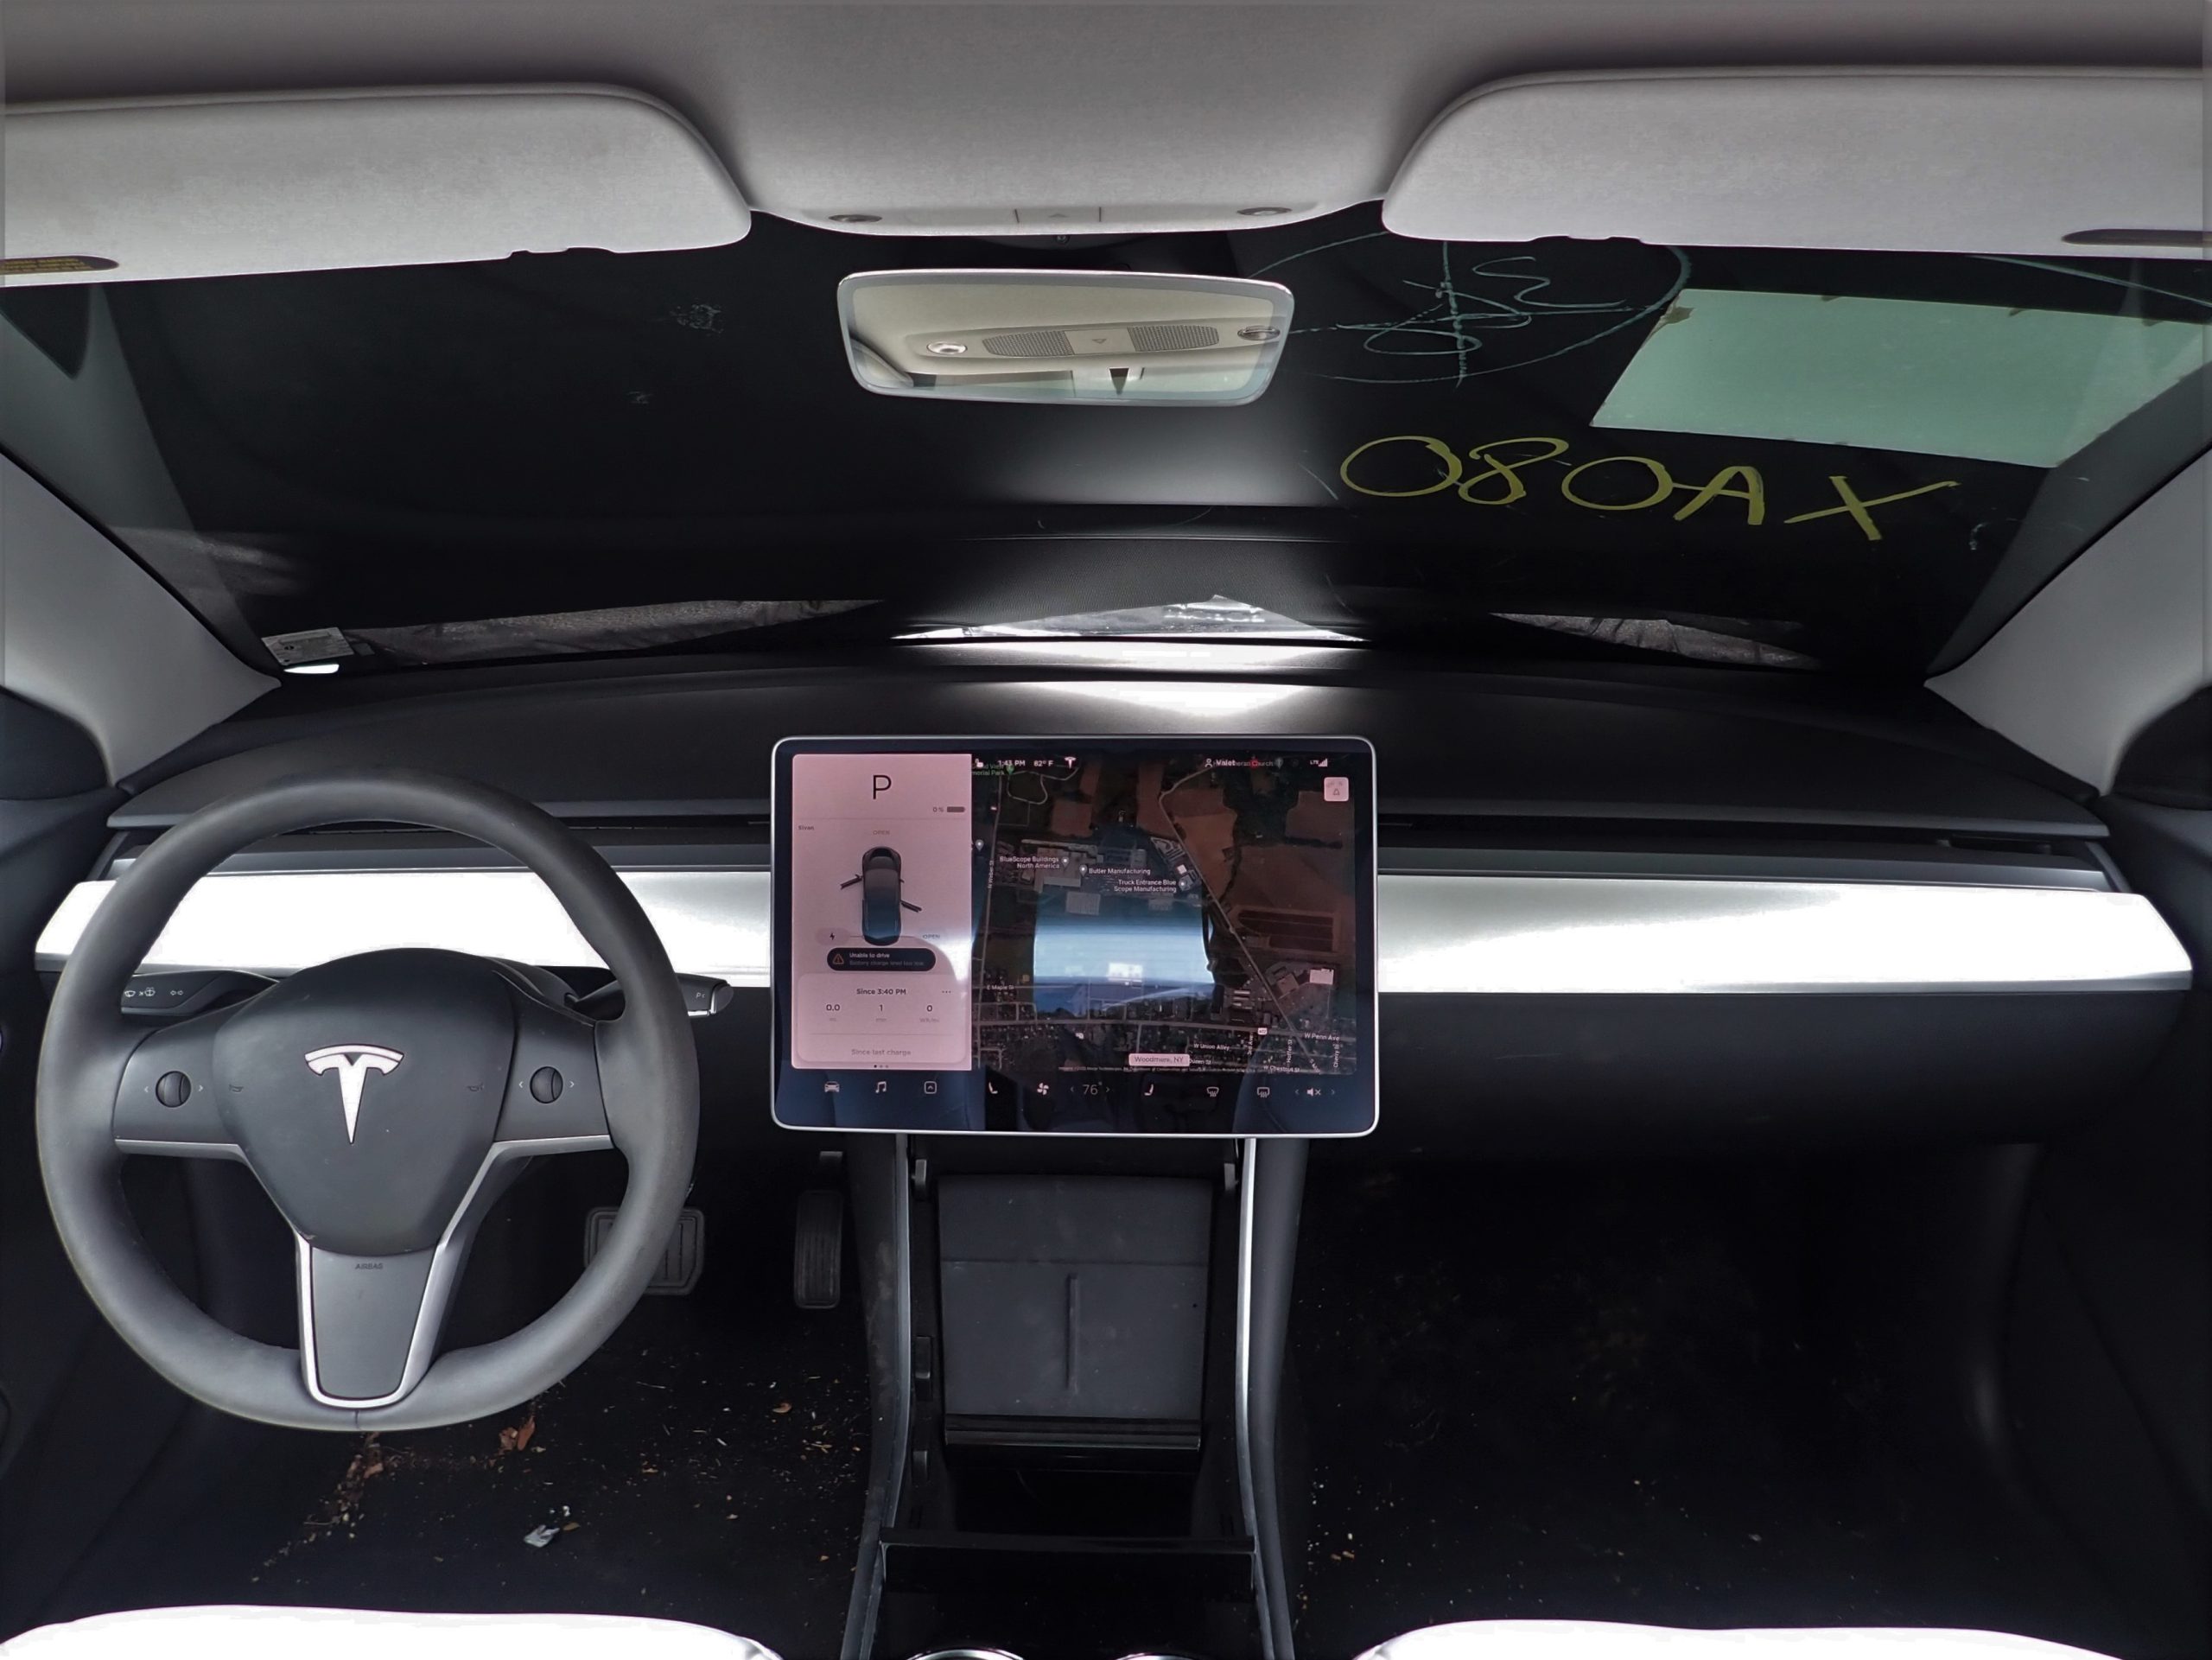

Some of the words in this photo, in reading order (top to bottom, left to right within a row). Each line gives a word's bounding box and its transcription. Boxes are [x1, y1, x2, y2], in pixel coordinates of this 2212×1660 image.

[873, 774, 892, 800] P
[826, 1003, 841, 1012] 0.0
[887, 1048, 912, 1057] charge
